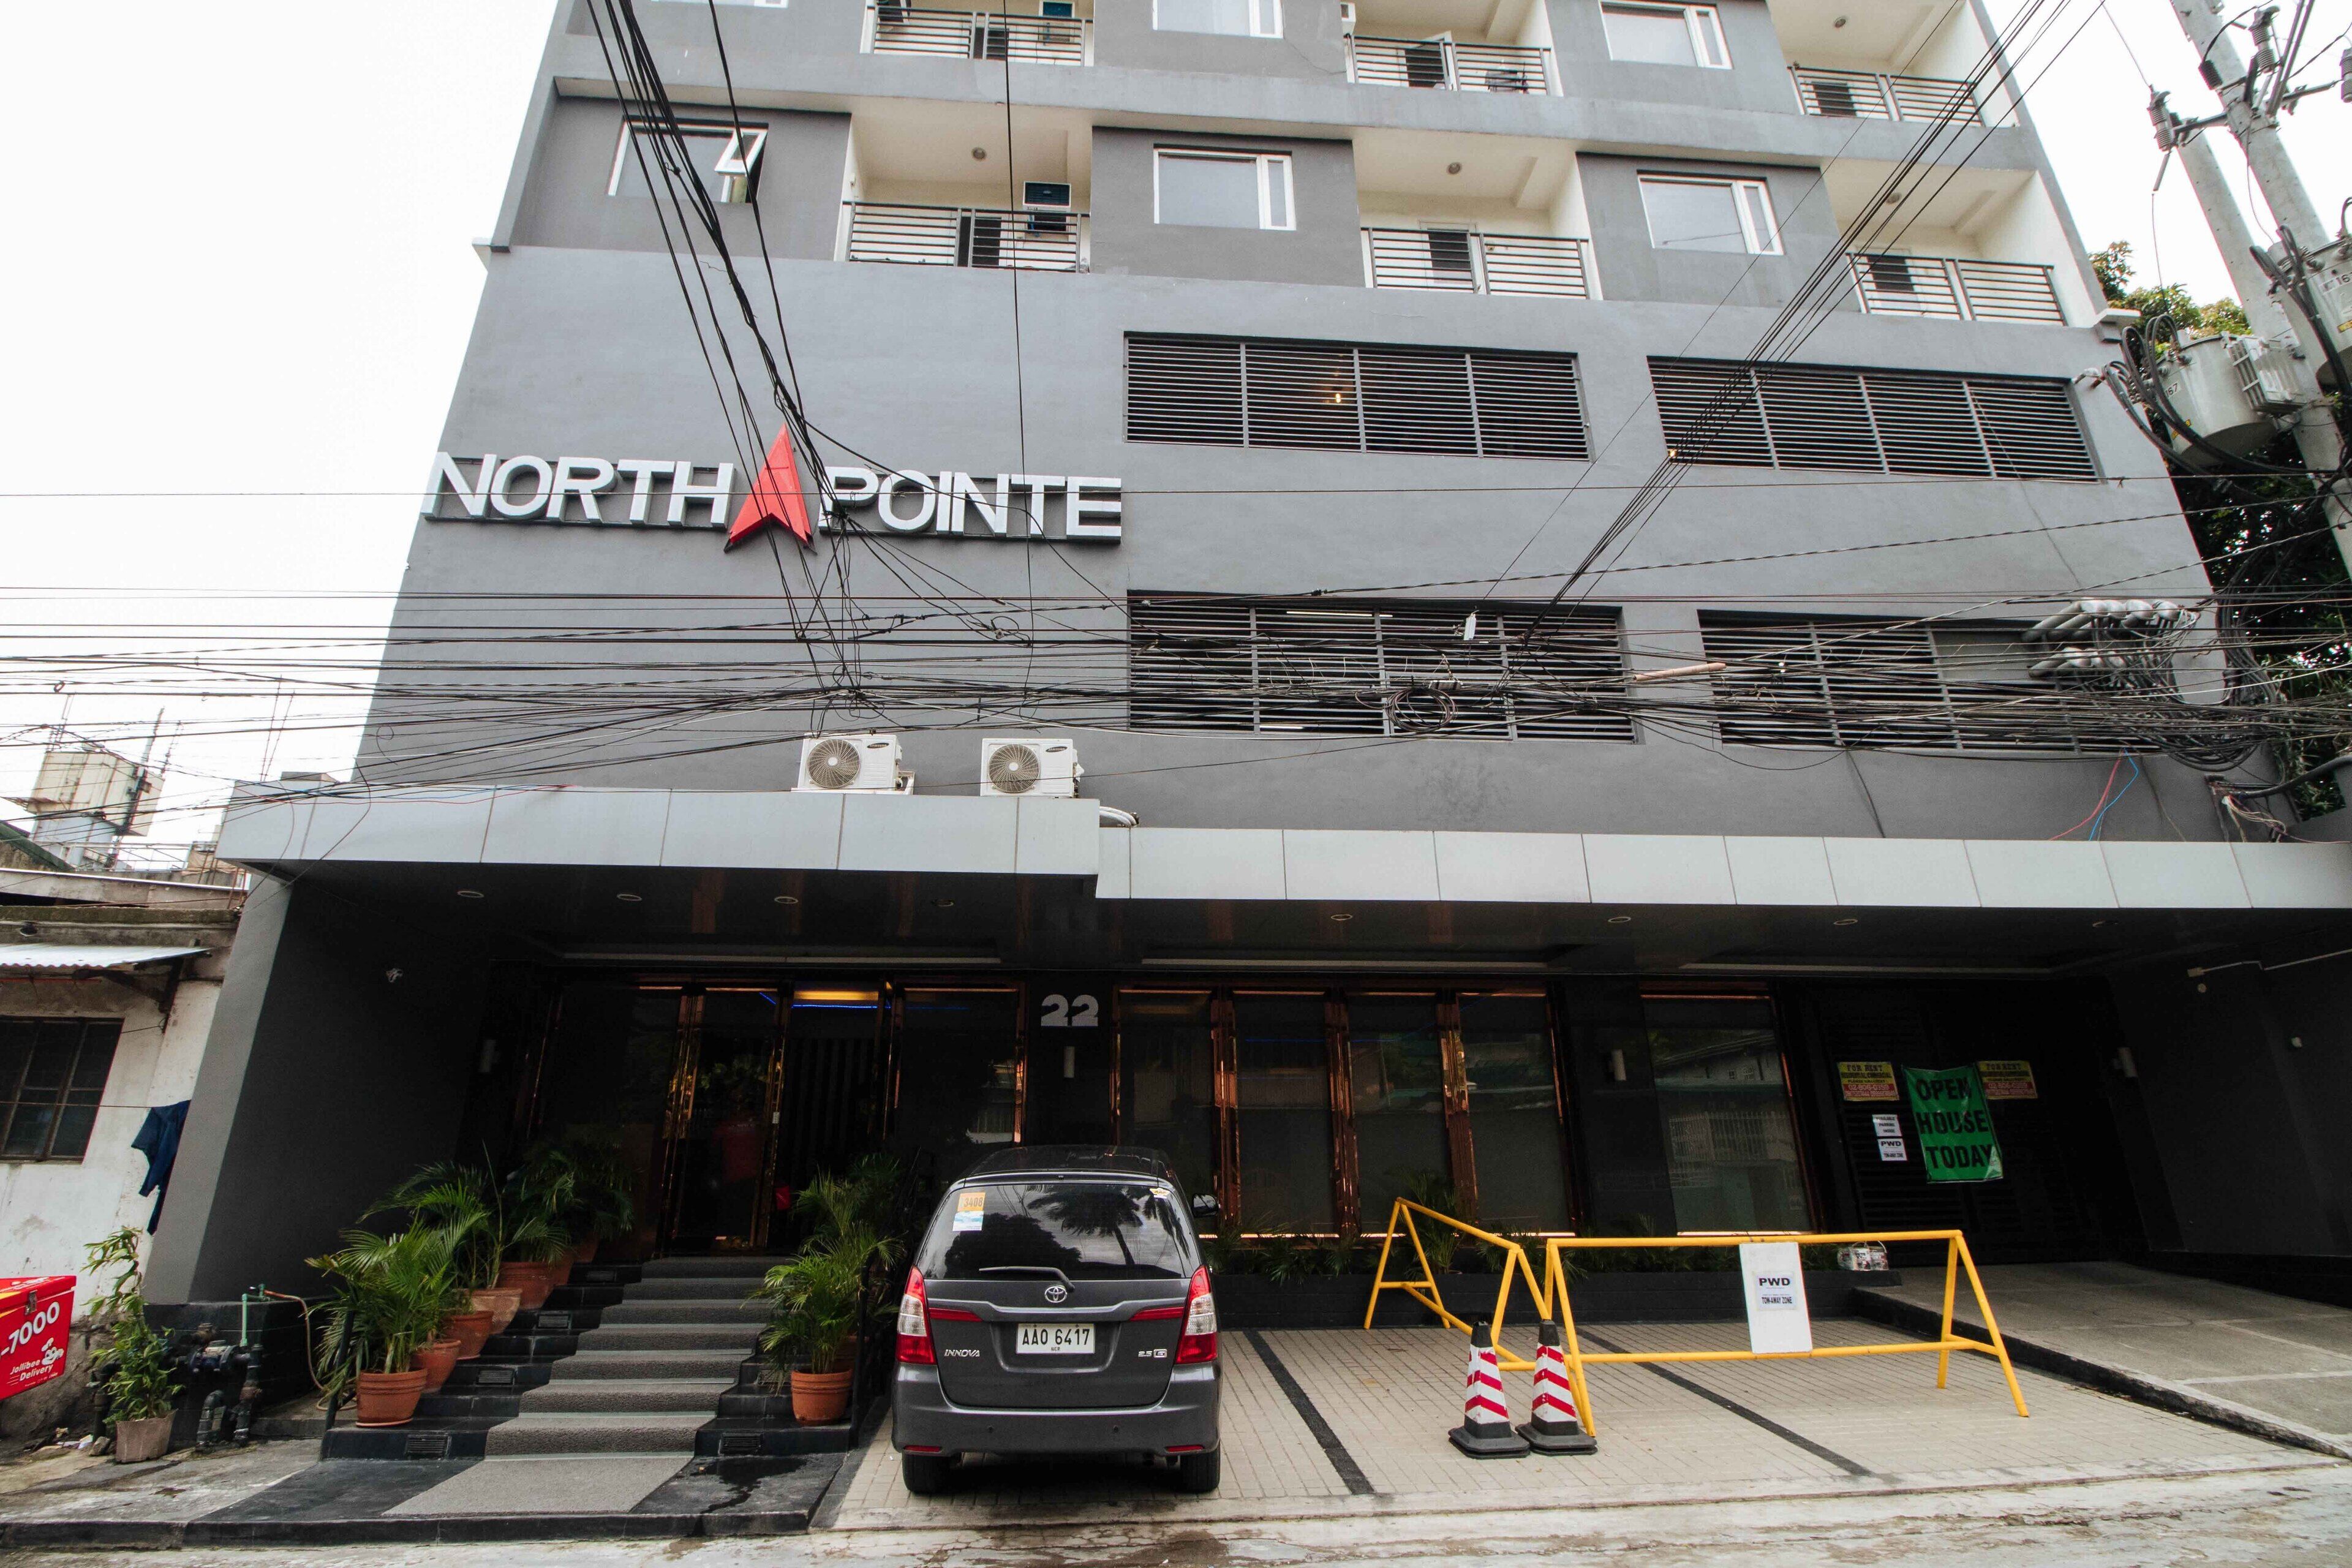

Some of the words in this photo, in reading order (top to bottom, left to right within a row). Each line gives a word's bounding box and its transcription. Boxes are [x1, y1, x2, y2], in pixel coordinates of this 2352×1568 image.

[2336, 272, 2352, 285] 16
[420, 452, 735, 529] NORTH
[818, 466, 1122, 543] POINTE
[1041, 993, 1099, 1027] 22
[1915, 1077, 1972, 1101] OPEN
[1915, 1109, 1989, 1134] HOUSE
[1925, 1144, 1994, 1169] TODAY
[1758, 1278, 1790, 1286] PWD
[0, 1302, 60, 1360] -7000
[1055, 1329, 1090, 1345] 6417
[10, 1359, 41, 1375] Jollibee
[20, 1364, 54, 1382] Delivery
